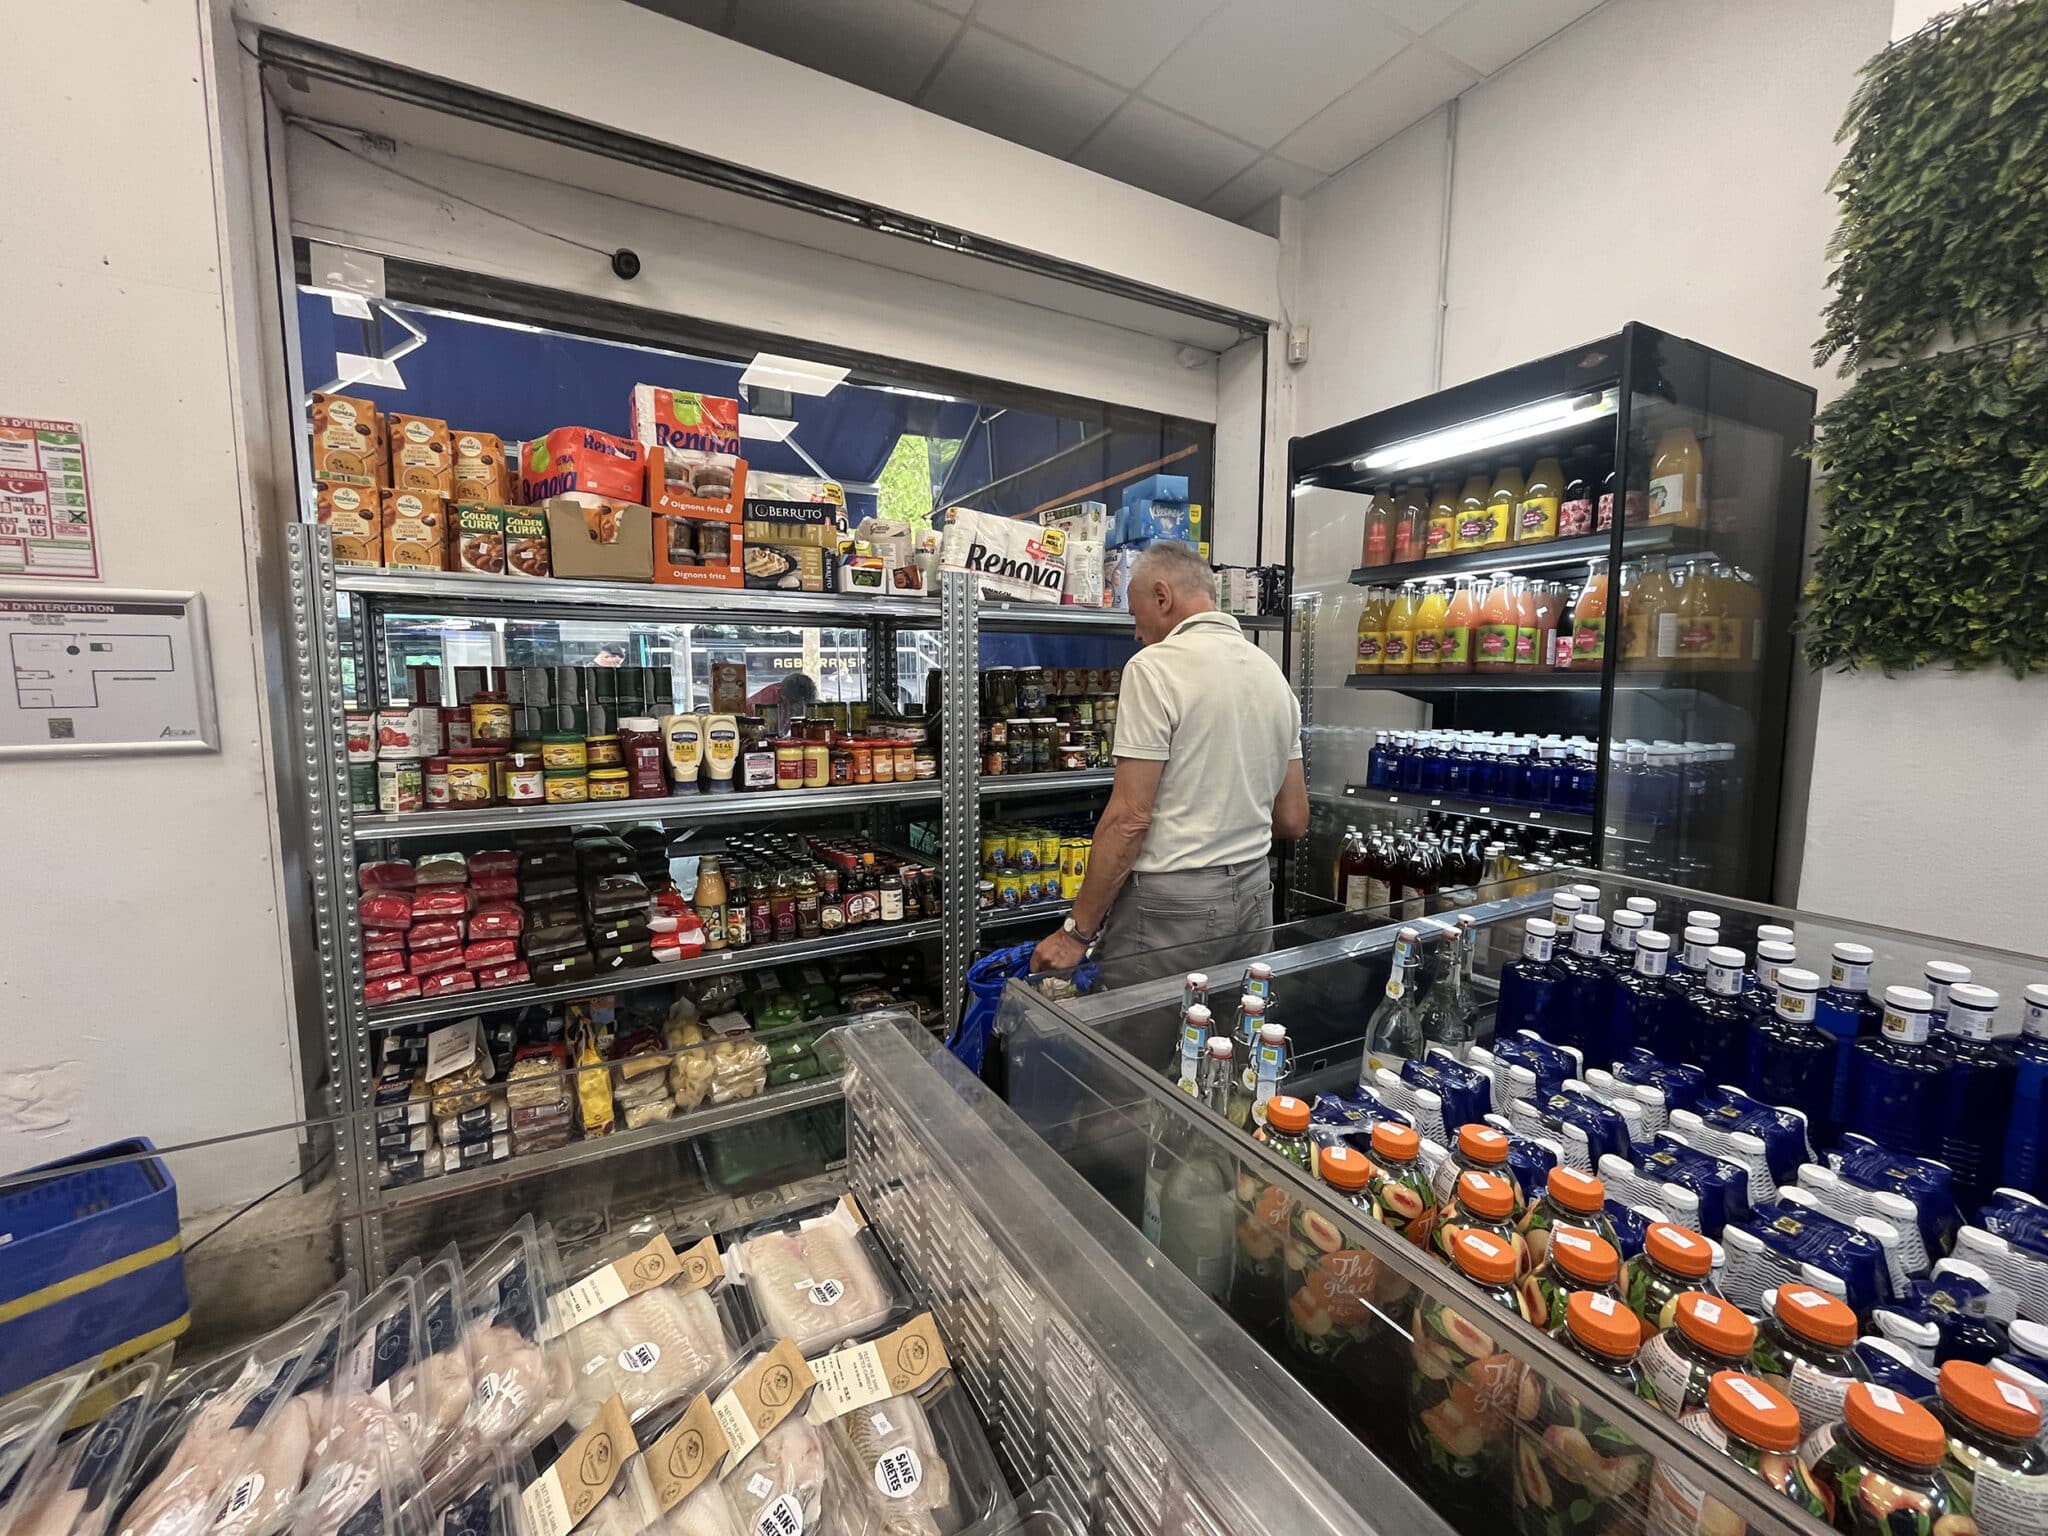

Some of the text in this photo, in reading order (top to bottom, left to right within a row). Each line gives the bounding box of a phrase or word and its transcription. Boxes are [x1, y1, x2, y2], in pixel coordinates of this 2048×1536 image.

[25, 505, 46, 515] 112
[670, 501, 724, 514] Oignons frits
[769, 506, 822, 520] BERRUTO
[461, 510, 499, 522] GOLDEN
[460, 519, 500, 530] CURRY
[506, 517, 543, 527] GOLDEN
[31, 525, 46, 536] 15
[505, 525, 544, 535] CURRY
[965, 543, 1062, 590] Renova
[673, 570, 727, 580] Oignons frits
[13, 603, 114, 613] D'INTERVENTION
[774, 658, 865, 669] AGB RANSP
[635, 1347, 652, 1367] SANS
[896, 1453, 914, 1484] SANS
[883, 1458, 902, 1492] ARÊTES
[773, 1503, 796, 1535] SANS
